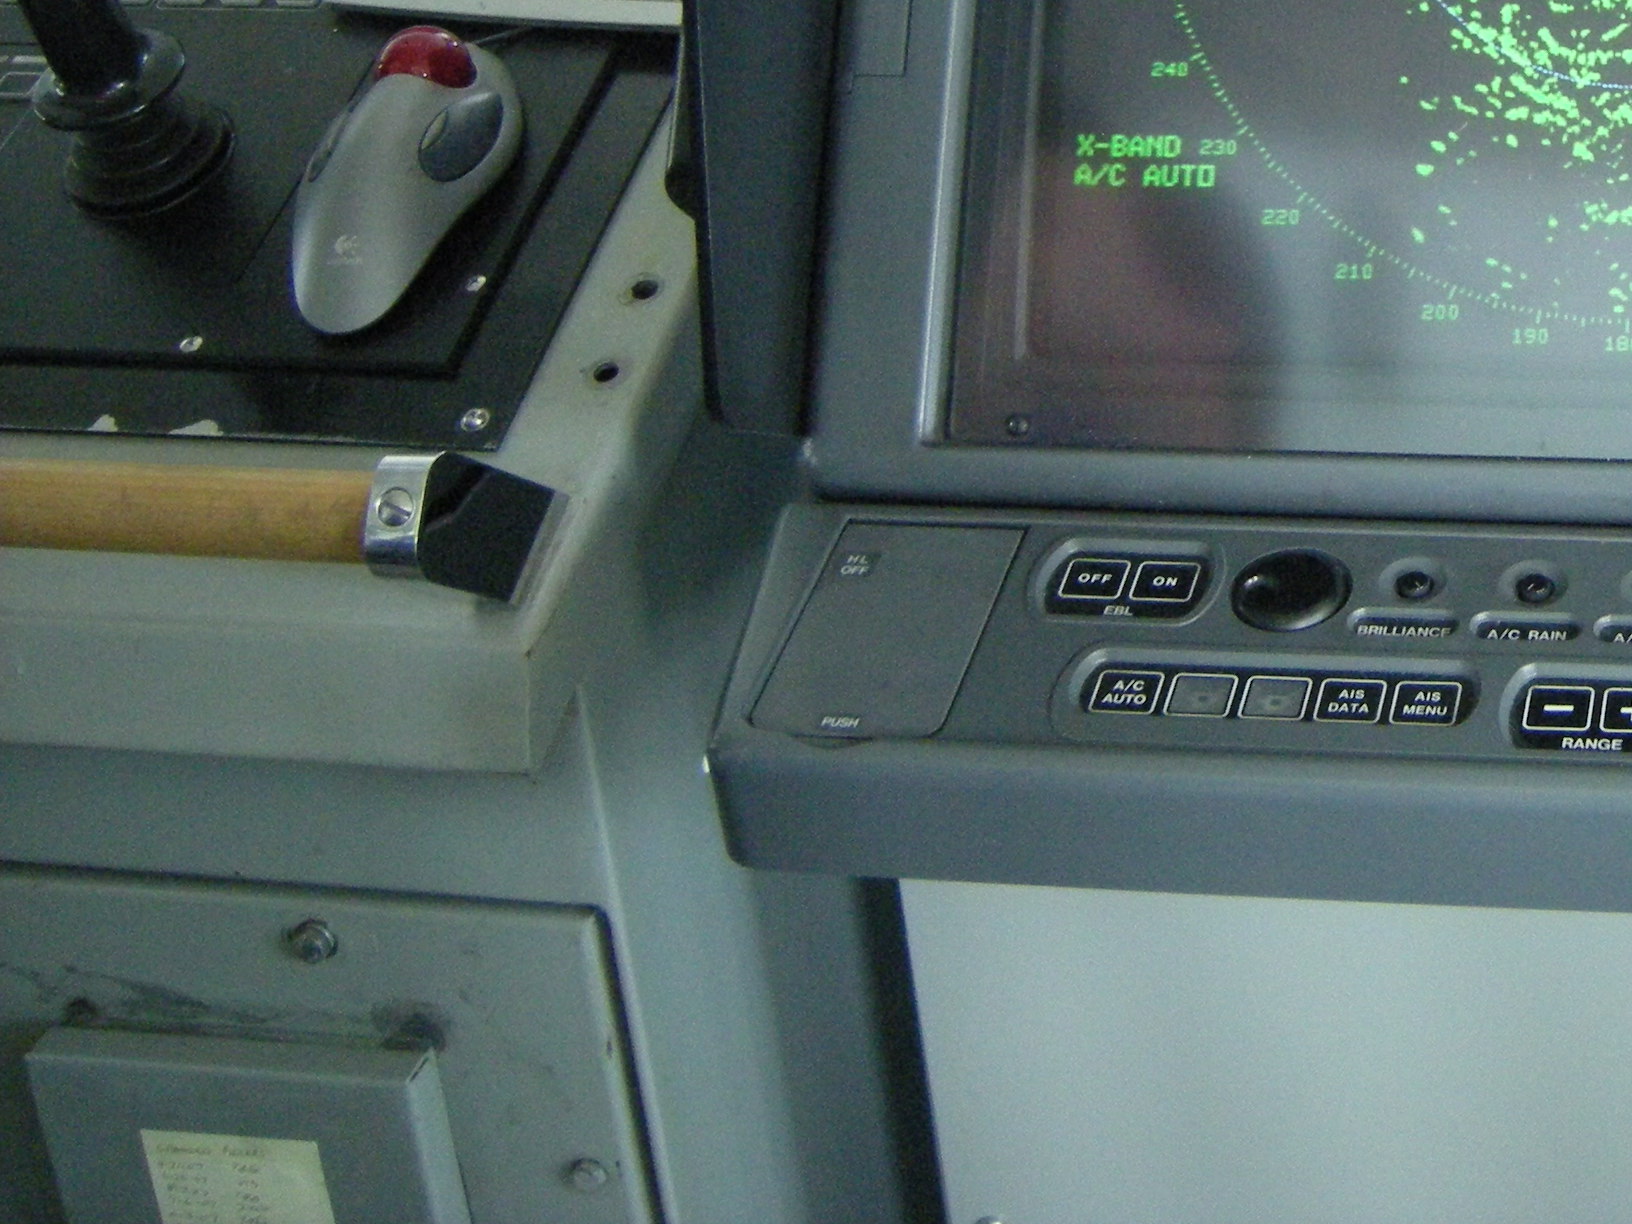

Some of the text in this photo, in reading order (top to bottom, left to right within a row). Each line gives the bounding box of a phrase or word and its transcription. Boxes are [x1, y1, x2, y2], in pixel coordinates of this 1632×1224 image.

[1151, 61, 1189, 76] 240
[1076, 134, 1182, 158] X-BAND
[1199, 139, 1237, 155] 230
[1073, 163, 1216, 188] A/C AUTO
[1261, 209, 1300, 226] 220
[1334, 263, 1373, 280] 210
[1421, 304, 1460, 321] 200
[1512, 328, 1549, 345] 190
[840, 564, 870, 575] OFF
[1077, 570, 1112, 585] OFF
[1152, 575, 1179, 588] ON
[1102, 604, 1134, 618] EBL
[1357, 624, 1452, 639] BRILLIANCE
[1486, 627, 1567, 642] A/C RAIN
[1111, 678, 1145, 692] A/C
[1101, 692, 1148, 707] AUTO
[1338, 688, 1366, 701] AIS
[1414, 690, 1442, 704] AIS
[1326, 701, 1370, 715] DATA
[1402, 703, 1448, 718] MENU
[820, 714, 860, 729] PUSH
[1561, 736, 1624, 752] RANGE
